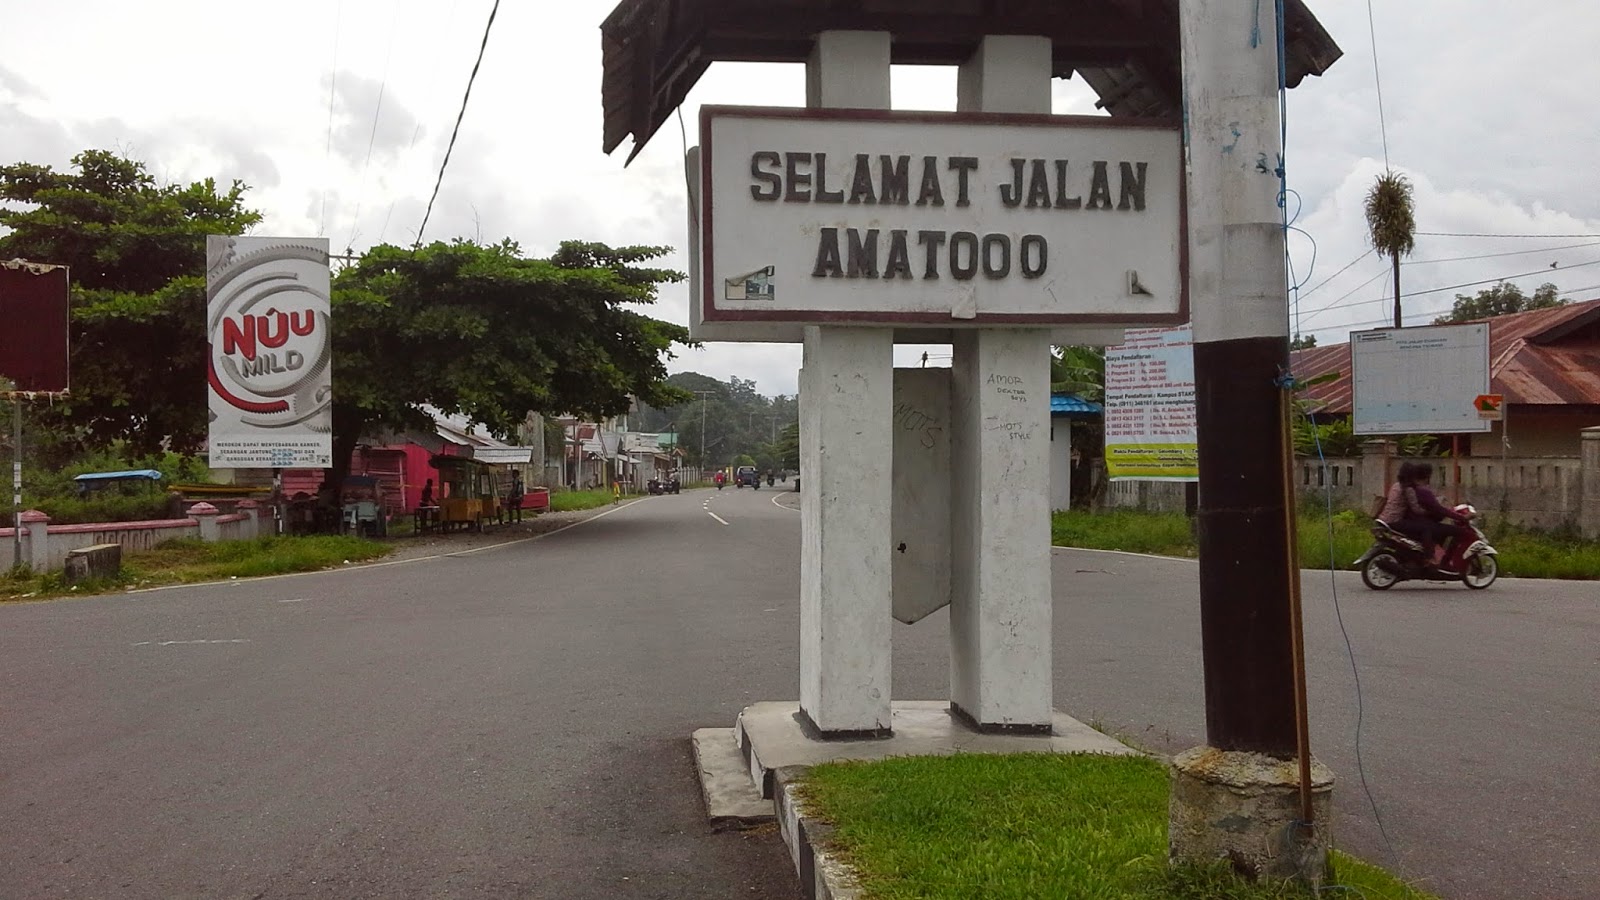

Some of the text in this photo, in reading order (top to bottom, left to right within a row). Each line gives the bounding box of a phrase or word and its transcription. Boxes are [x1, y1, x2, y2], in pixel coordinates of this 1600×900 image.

[750, 150, 1148, 211] SELAMAT JALAN
[811, 227, 1048, 279] AMATOOO
[242, 350, 304, 378] MILD
[986, 373, 1024, 385] AMOR
[1009, 432, 1031, 440] STYLE
